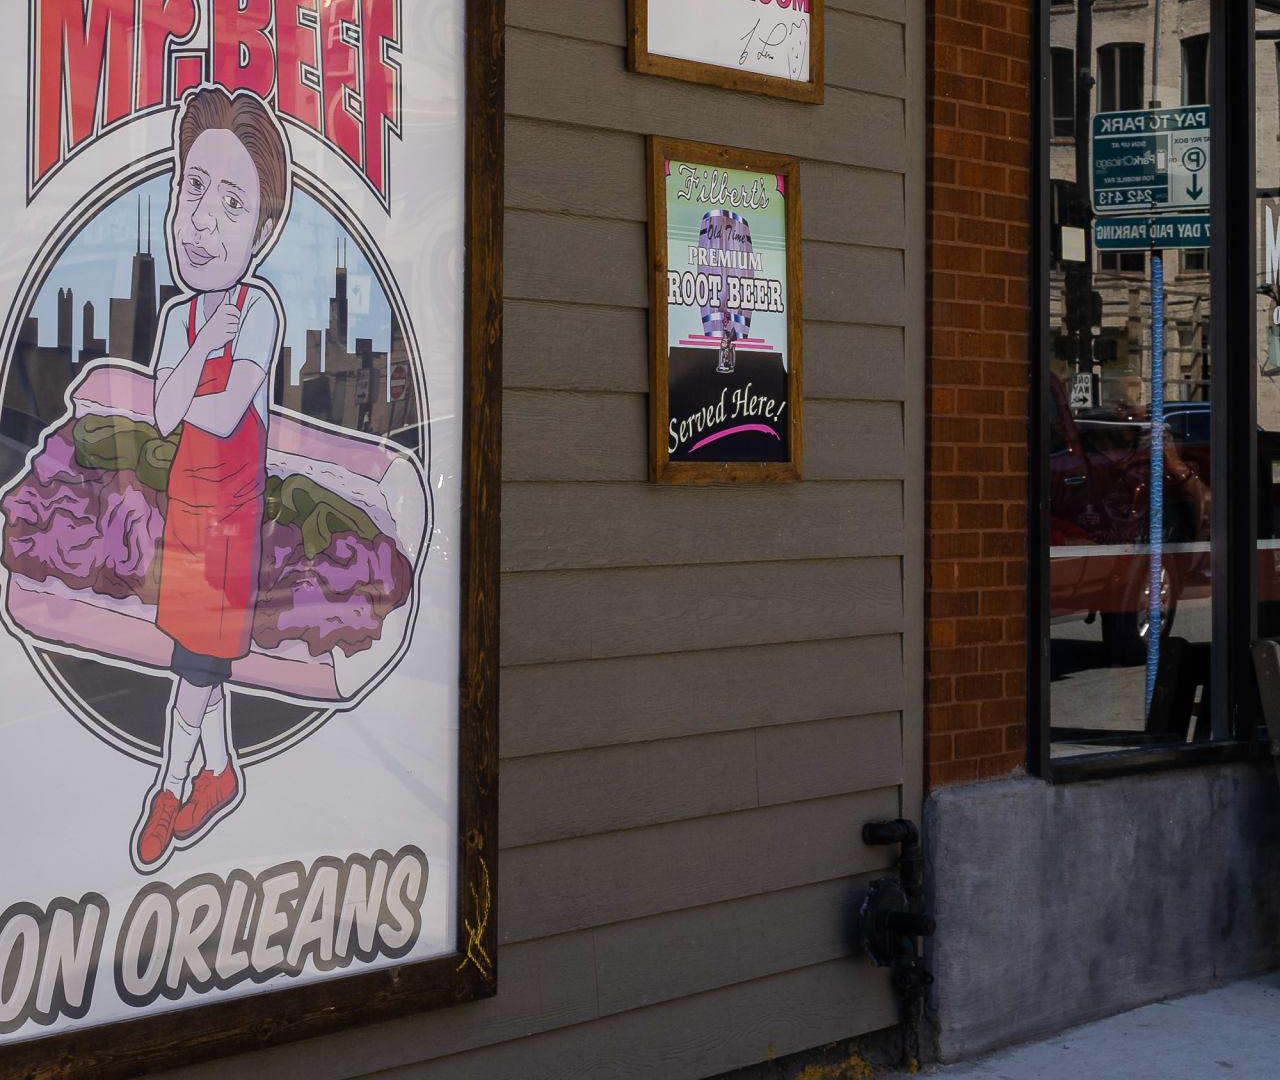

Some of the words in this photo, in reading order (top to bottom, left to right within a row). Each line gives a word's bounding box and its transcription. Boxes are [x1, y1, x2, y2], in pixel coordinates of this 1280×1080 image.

[677, 164, 770, 210] Filbert's
[708, 224, 722, 240] Old
[725, 224, 745, 243] Time
[688, 245, 763, 271] PREMIUM
[667, 270, 722, 308] ROOT
[727, 275, 784, 312] BEER
[668, 388, 728, 454] Served
[731, 383, 786, 422] Here!
[114, 845, 429, 1008] ORLEANS
